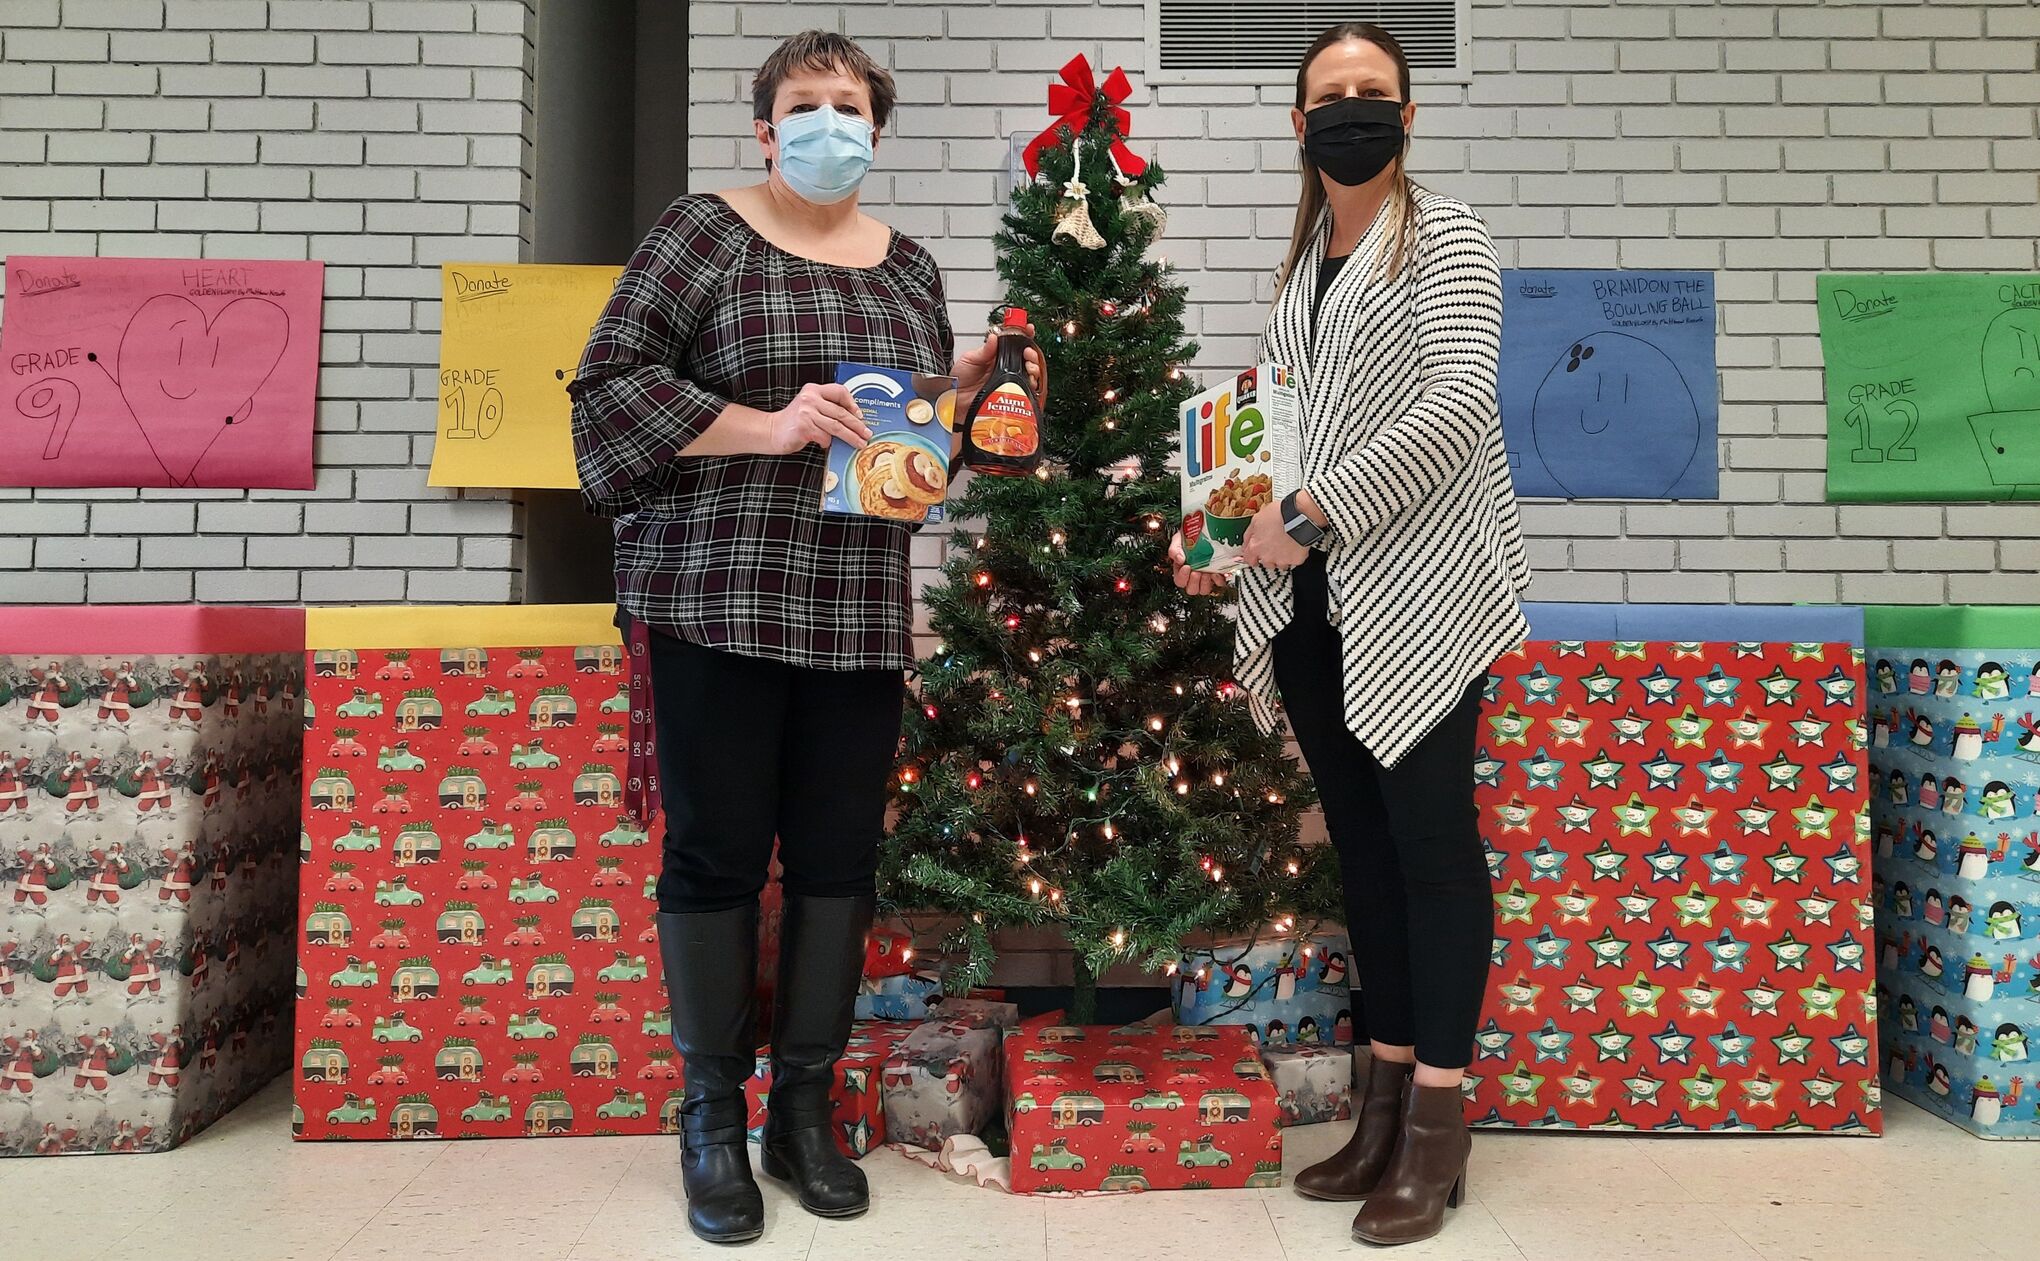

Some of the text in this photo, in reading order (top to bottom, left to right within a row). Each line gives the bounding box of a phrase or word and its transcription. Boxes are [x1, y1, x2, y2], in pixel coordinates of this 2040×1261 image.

[16, 266, 80, 292] Donate
[182, 267, 254, 287] HEART
[451, 270, 512, 295] Donate
[1519, 279, 1558, 294] donate
[1592, 277, 1705, 300] BRANDON THE
[1602, 301, 1668, 320] BOWLING
[1672, 296, 1710, 313] BALL
[1832, 289, 1898, 318] Donate
[11, 347, 81, 376] GRADE
[440, 369, 501, 386] GRADE
[1271, 366, 1297, 389] life
[854, 397, 901, 409] compliments
[996, 396, 1026, 407] Aunt
[1847, 378, 1917, 405] GRADE
[16, 377, 81, 460] 9
[445, 386, 504, 440] 10
[987, 401, 1033, 416] Jemima
[1186, 391, 1265, 478] life
[1844, 399, 1919, 463] 12
[633, 674, 641, 690] SCI
[633, 741, 641, 757] SCI
[648, 776, 657, 792] SCI
